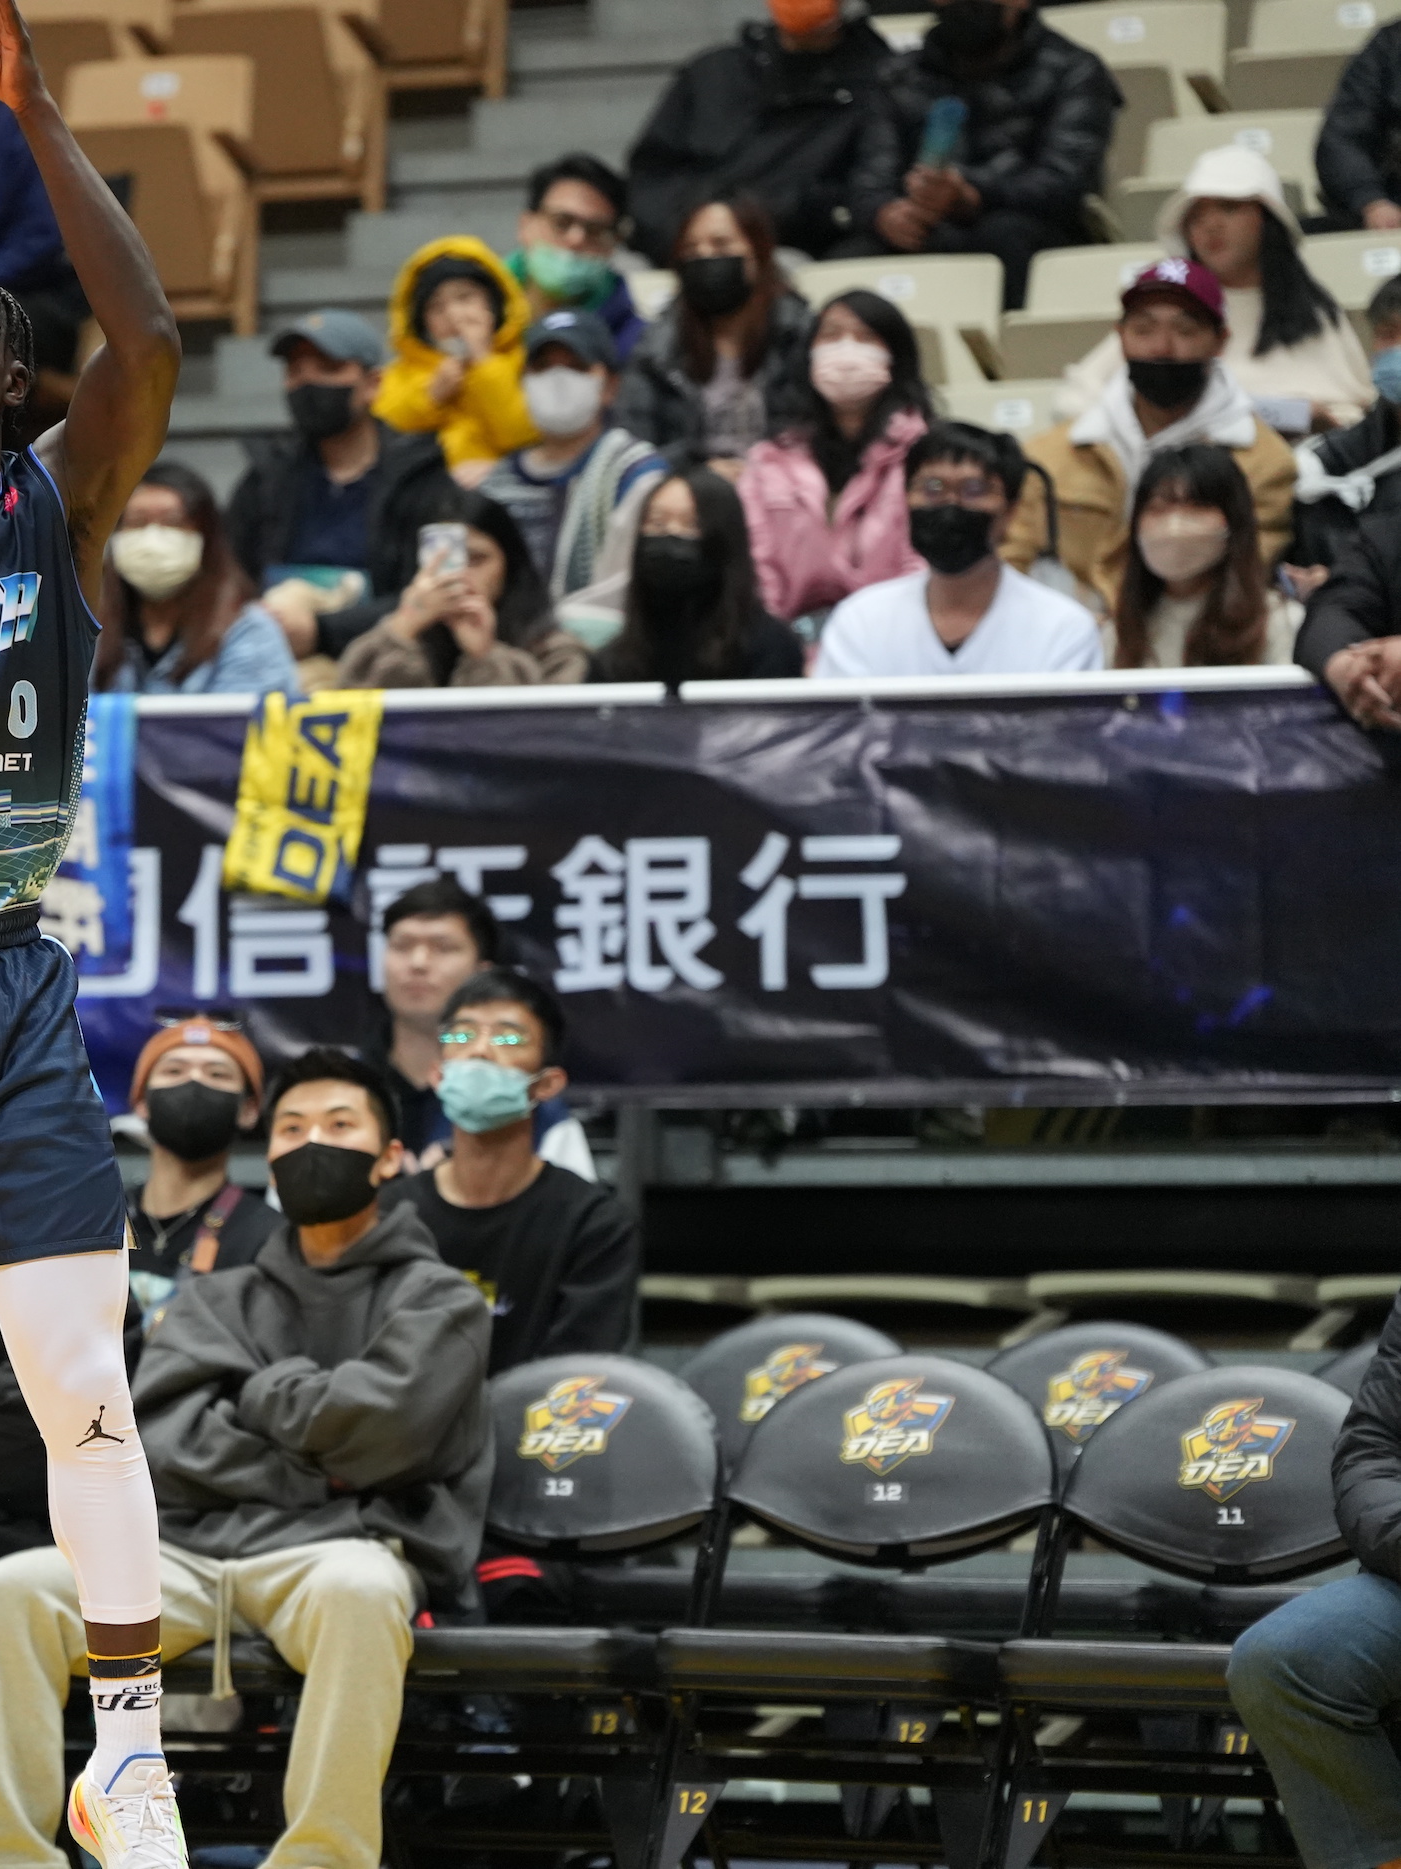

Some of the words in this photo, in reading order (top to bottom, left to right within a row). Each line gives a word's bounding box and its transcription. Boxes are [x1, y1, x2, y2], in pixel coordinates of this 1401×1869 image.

[8, 679, 38, 739] 0
[272, 711, 350, 893] DEA
[519, 1428, 605, 1456] DEA
[843, 1429, 931, 1461] DEA
[1181, 1453, 1270, 1487] DEA
[544, 1478, 575, 1497] 13
[873, 1482, 903, 1502] 12
[1216, 1506, 1246, 1526] 11
[591, 1712, 619, 1735] 13
[899, 1721, 928, 1743] 12
[1223, 1731, 1249, 1755] 11
[678, 1790, 709, 1815] 12
[1022, 1799, 1049, 1824] 11
